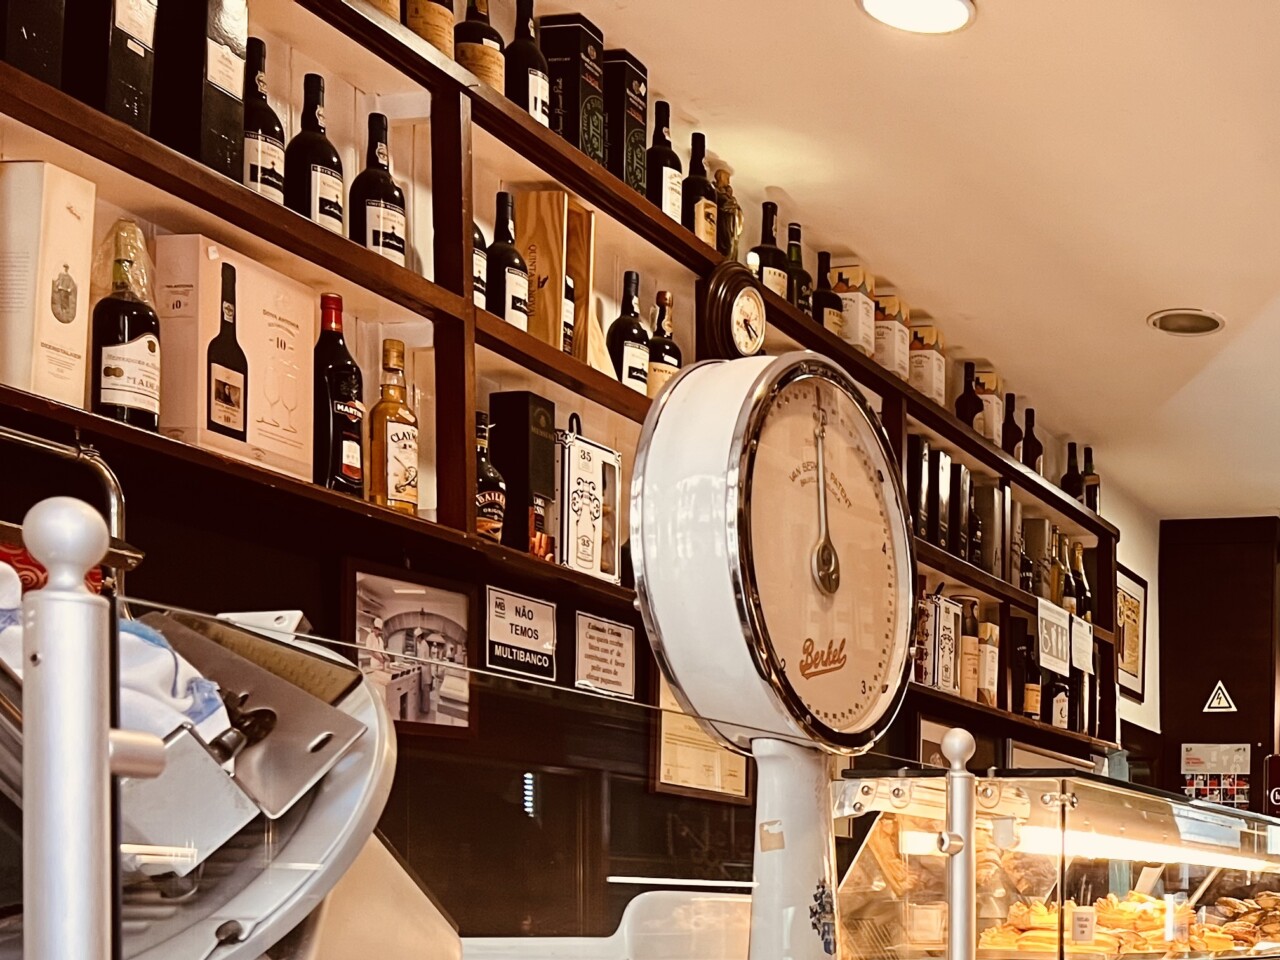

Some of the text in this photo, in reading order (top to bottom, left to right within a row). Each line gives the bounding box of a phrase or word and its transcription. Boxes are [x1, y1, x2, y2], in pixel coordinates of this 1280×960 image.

[528, 244, 538, 280] QUINTA
[580, 449, 592, 462] 35
[495, 600, 506, 611] MB
[515, 605, 534, 620] NÃO
[509, 622, 539, 640] TEMOS
[494, 644, 549, 667] MULTIBANCO
[799, 638, 847, 680] Berkel
[861, 680, 867, 694] 3
